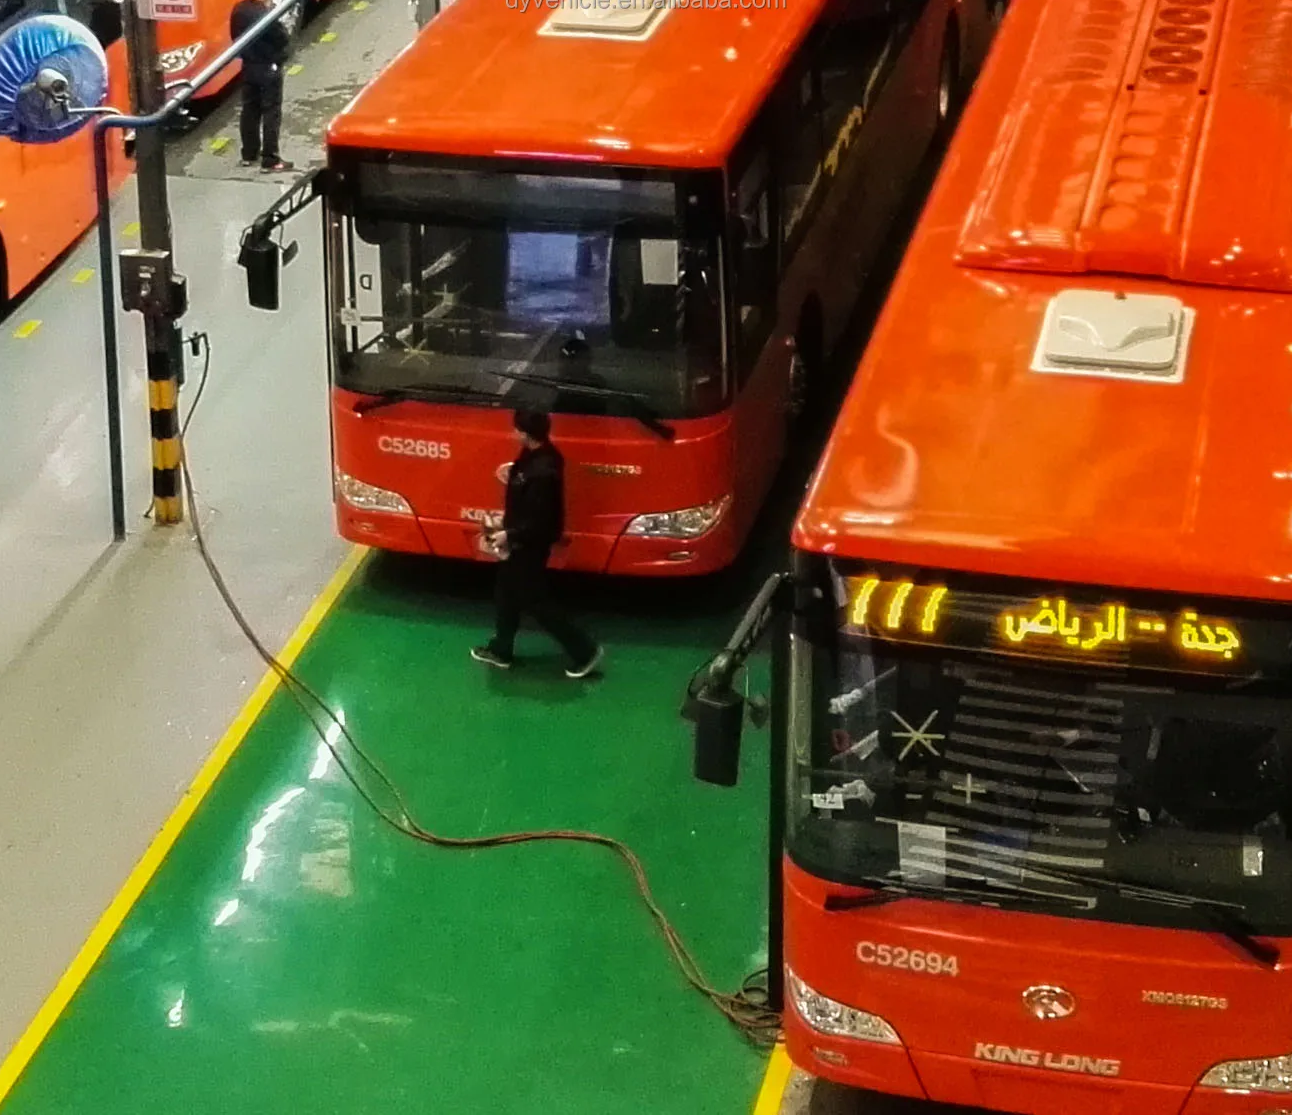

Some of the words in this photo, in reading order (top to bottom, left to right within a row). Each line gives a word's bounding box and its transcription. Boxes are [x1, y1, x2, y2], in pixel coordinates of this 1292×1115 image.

[378, 436, 451, 460] C52685
[1005, 600, 1125, 650] الرياض
[1182, 613, 1240, 659] جدة
[856, 941, 960, 978] C52694
[974, 1042, 1041, 1068] KING
[1043, 1052, 1122, 1076] LONG
